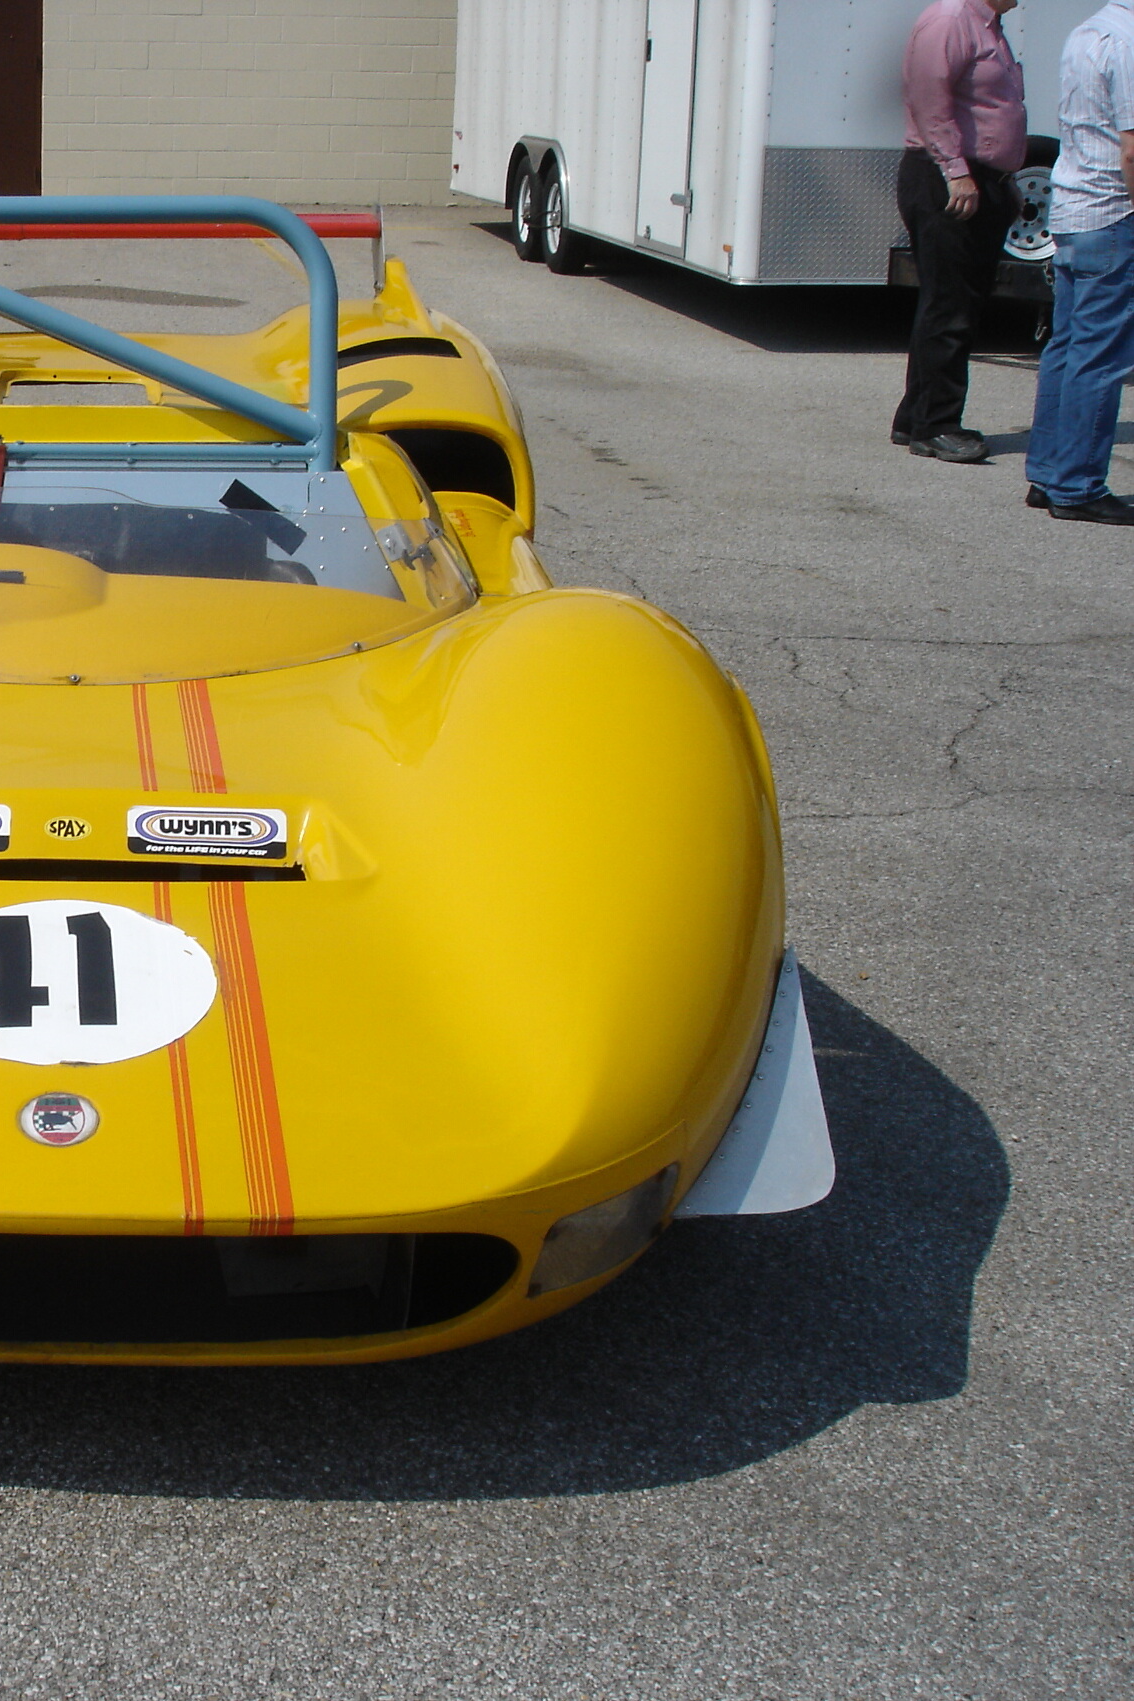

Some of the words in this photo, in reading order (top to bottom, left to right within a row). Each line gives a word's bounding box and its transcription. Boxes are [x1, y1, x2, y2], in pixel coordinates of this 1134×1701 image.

[49, 819, 85, 837] SPAX
[164, 845, 184, 853] the
[184, 845, 209, 854] LIFE
[209, 846, 220, 854] in
[220, 847, 248, 856] your
[248, 848, 268, 856] car
